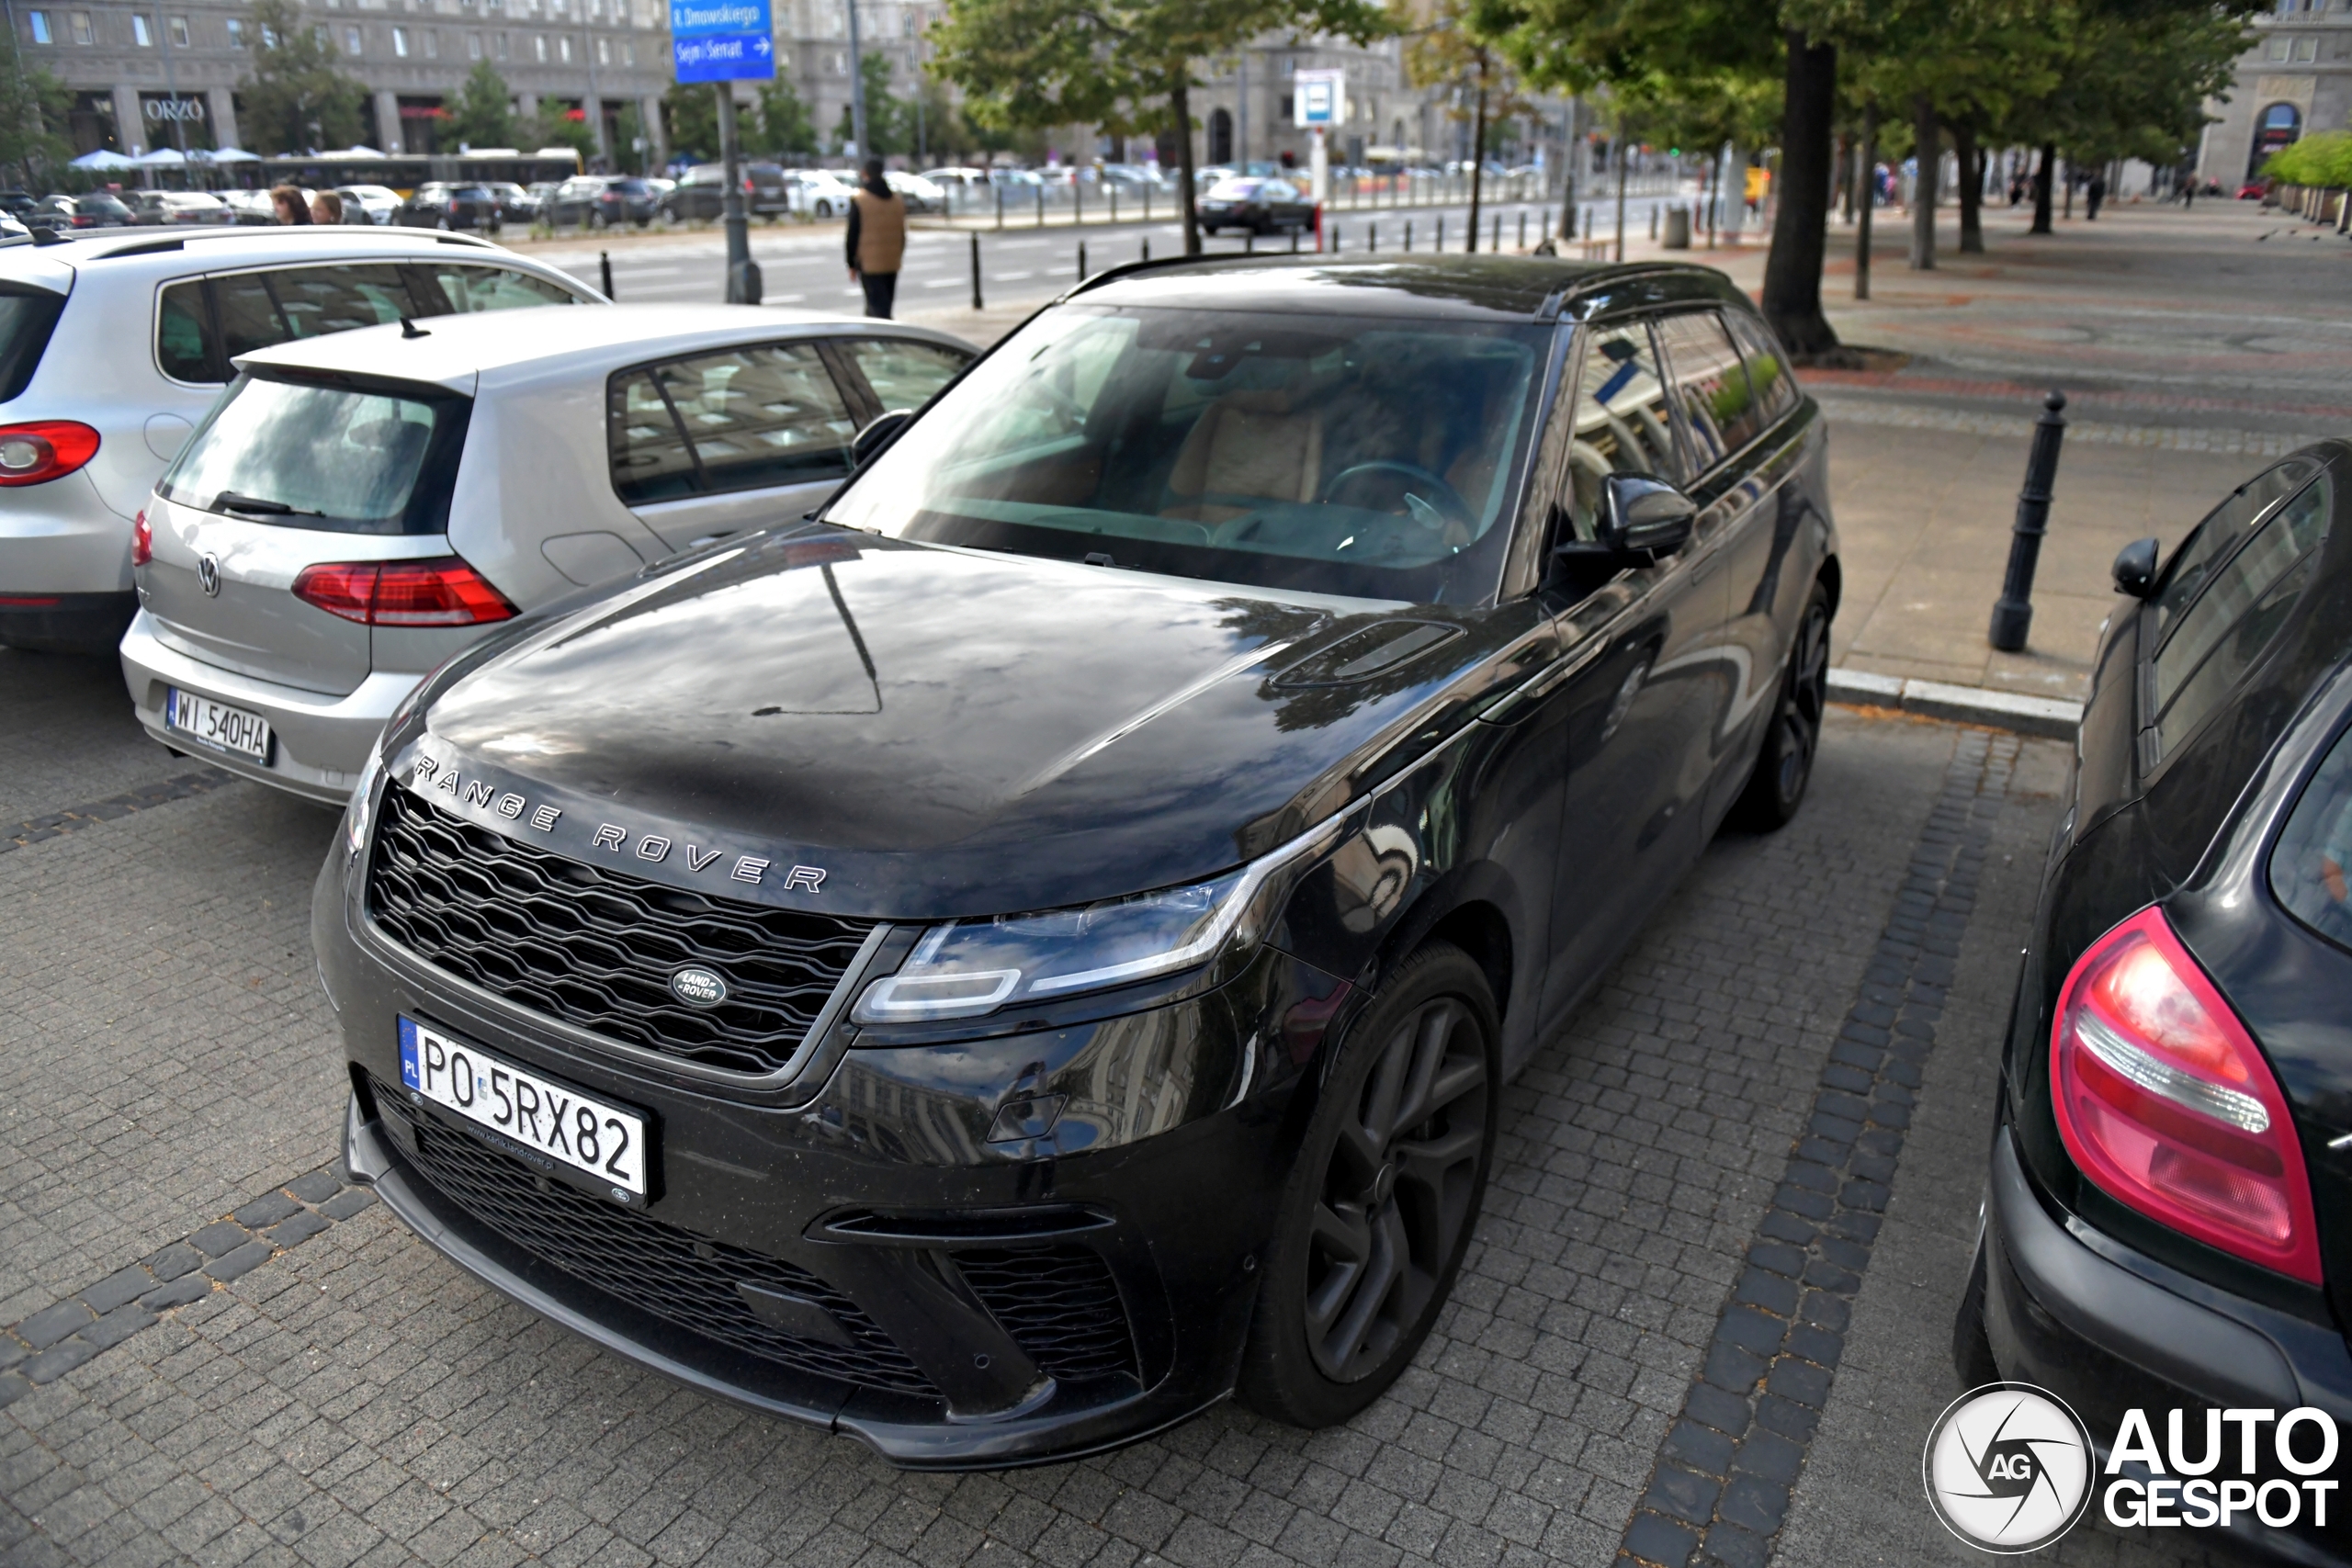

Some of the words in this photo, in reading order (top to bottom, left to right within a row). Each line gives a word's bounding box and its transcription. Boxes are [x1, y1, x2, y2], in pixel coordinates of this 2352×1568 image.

[684, 4, 761, 28] Dmowskiego
[676, 42, 700, 66] Sejm
[707, 39, 743, 61] Senat
[146, 100, 205, 121] ORZO
[178, 694, 198, 731] WI
[207, 704, 265, 754] 540HA
[414, 755, 561, 832] RANGE
[593, 823, 827, 894] ROVER
[682, 972, 710, 987] LAND
[682, 983, 717, 1000] ROVER
[404, 1059, 418, 1079] PL
[424, 1035, 475, 1108] PO
[491, 1066, 630, 1181] 5RX82
